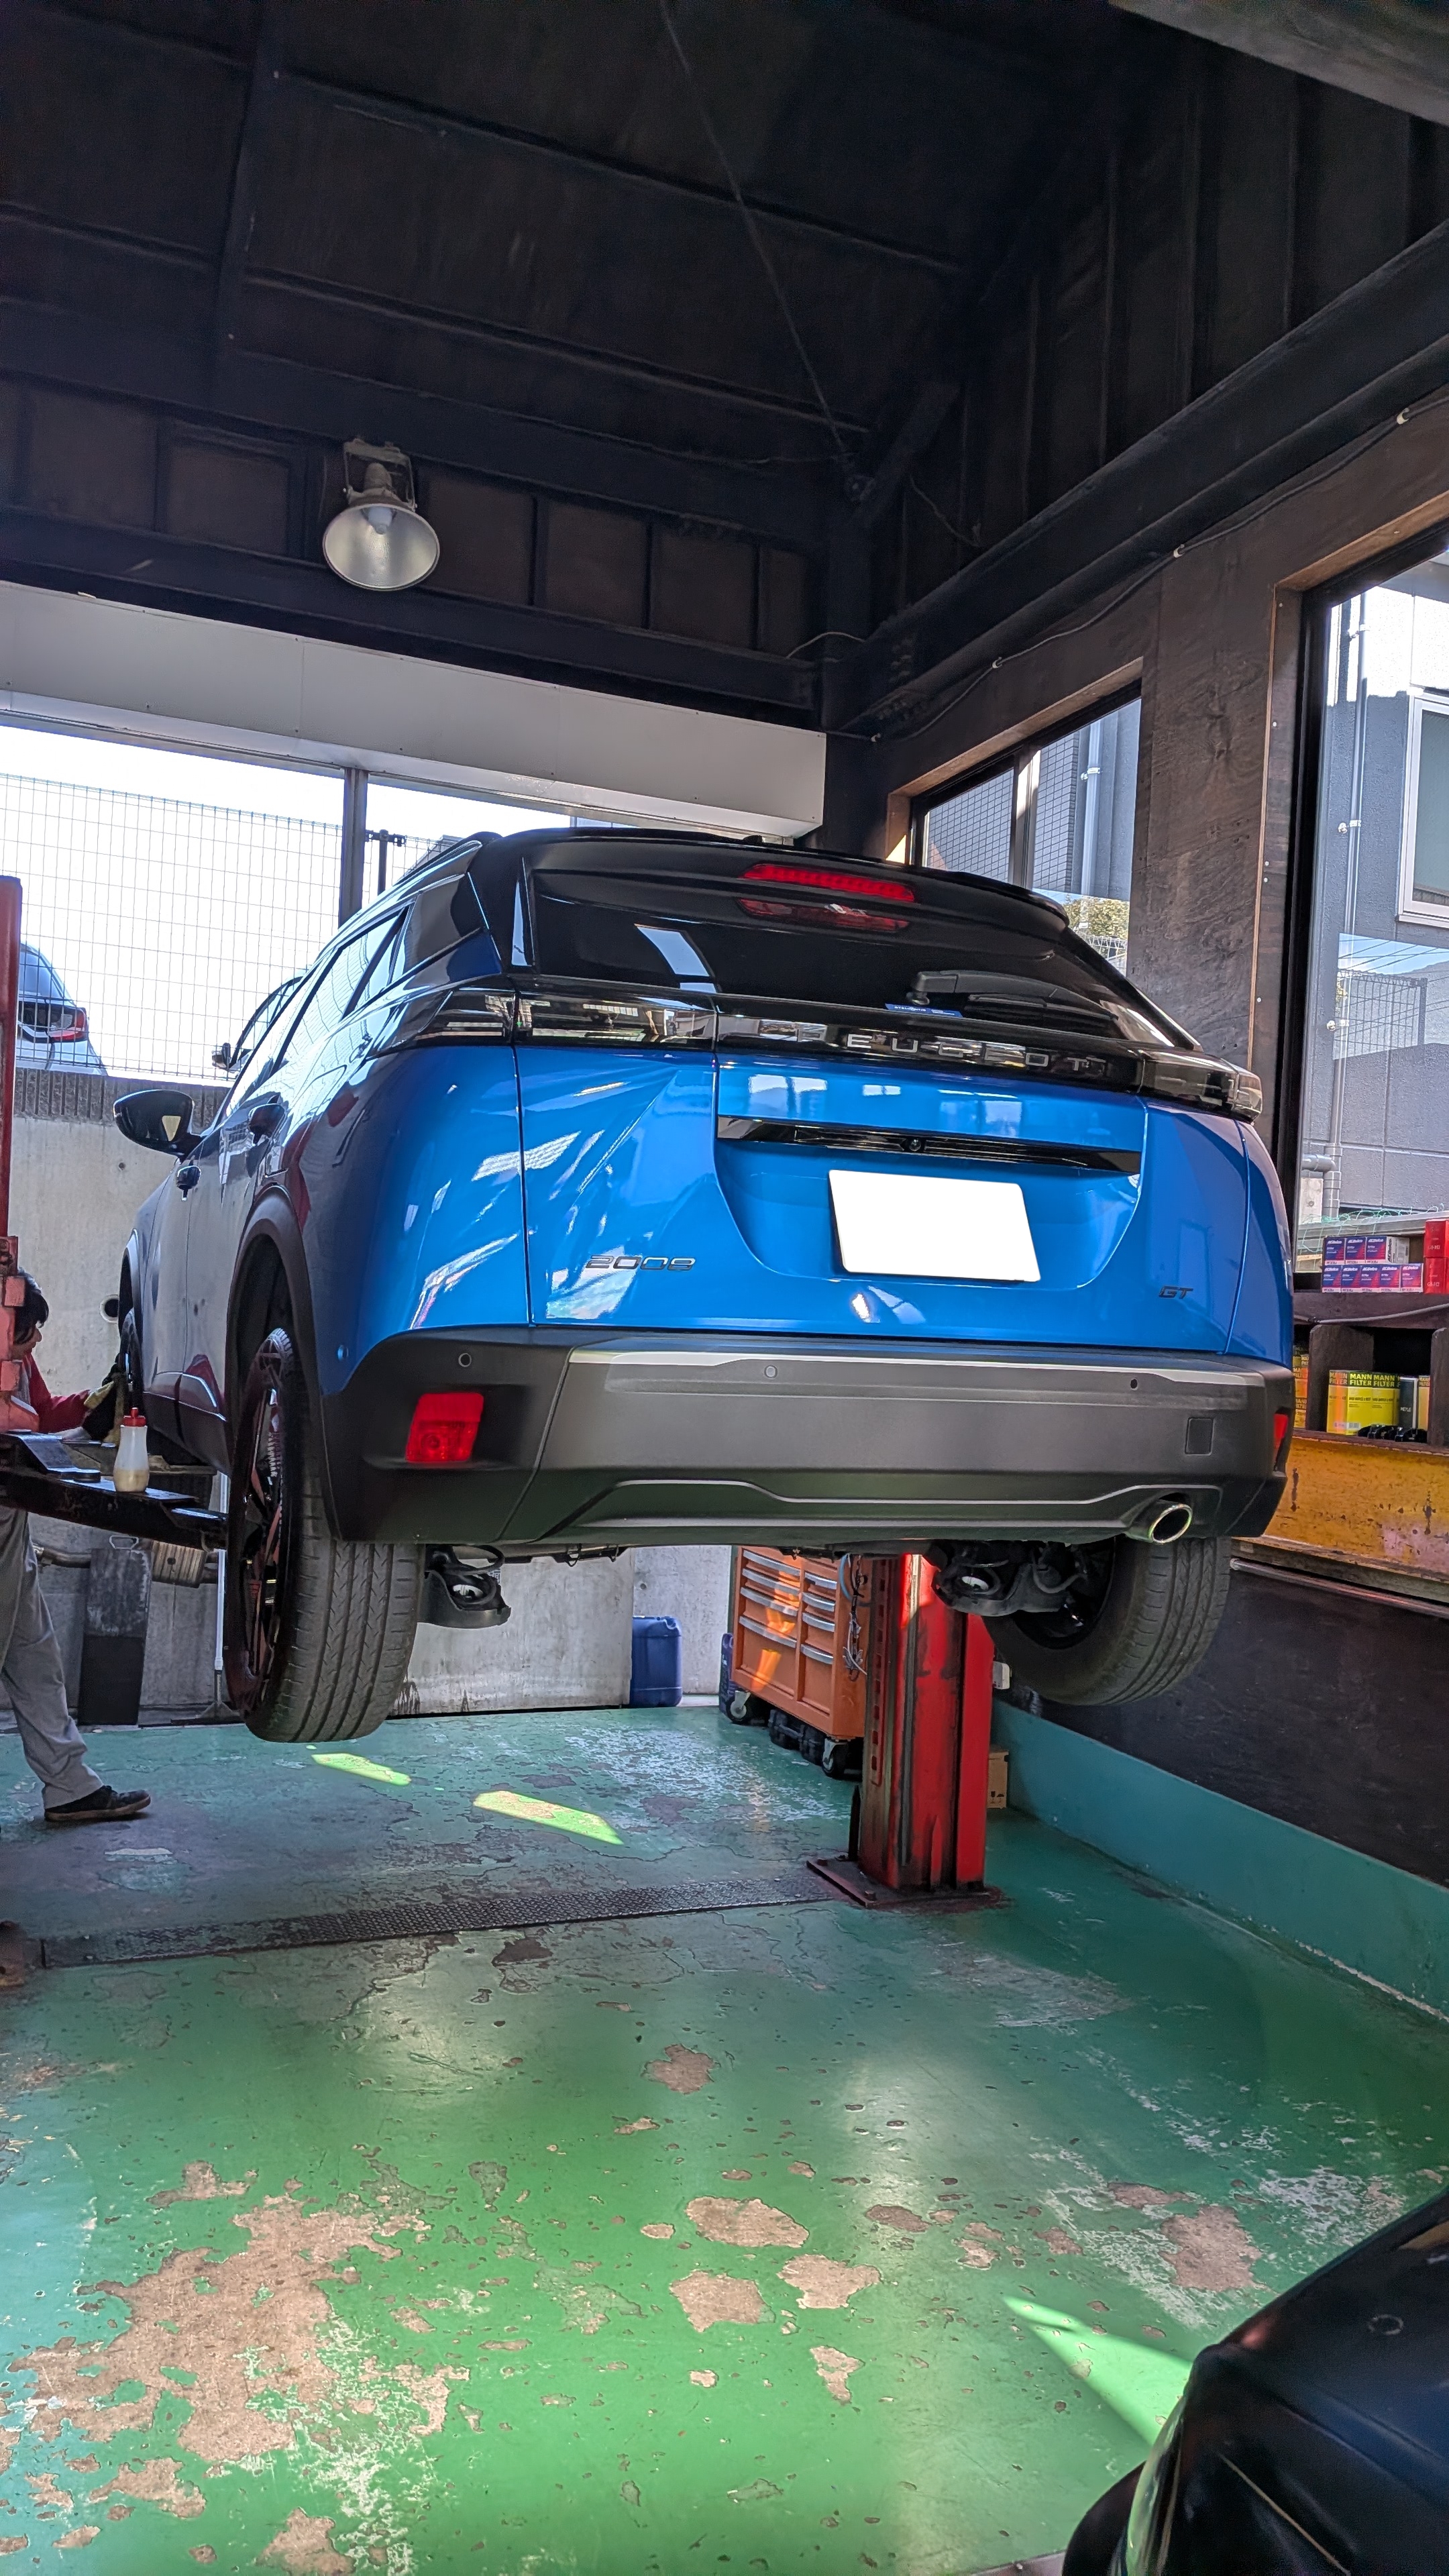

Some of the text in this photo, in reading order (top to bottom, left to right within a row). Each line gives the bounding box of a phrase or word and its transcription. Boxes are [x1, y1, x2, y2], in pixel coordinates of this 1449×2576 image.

[797, 1028, 1088, 1071] PEUGEOT
[585, 1254, 696, 1271] 2008
[1159, 1285, 1194, 1299] GT
